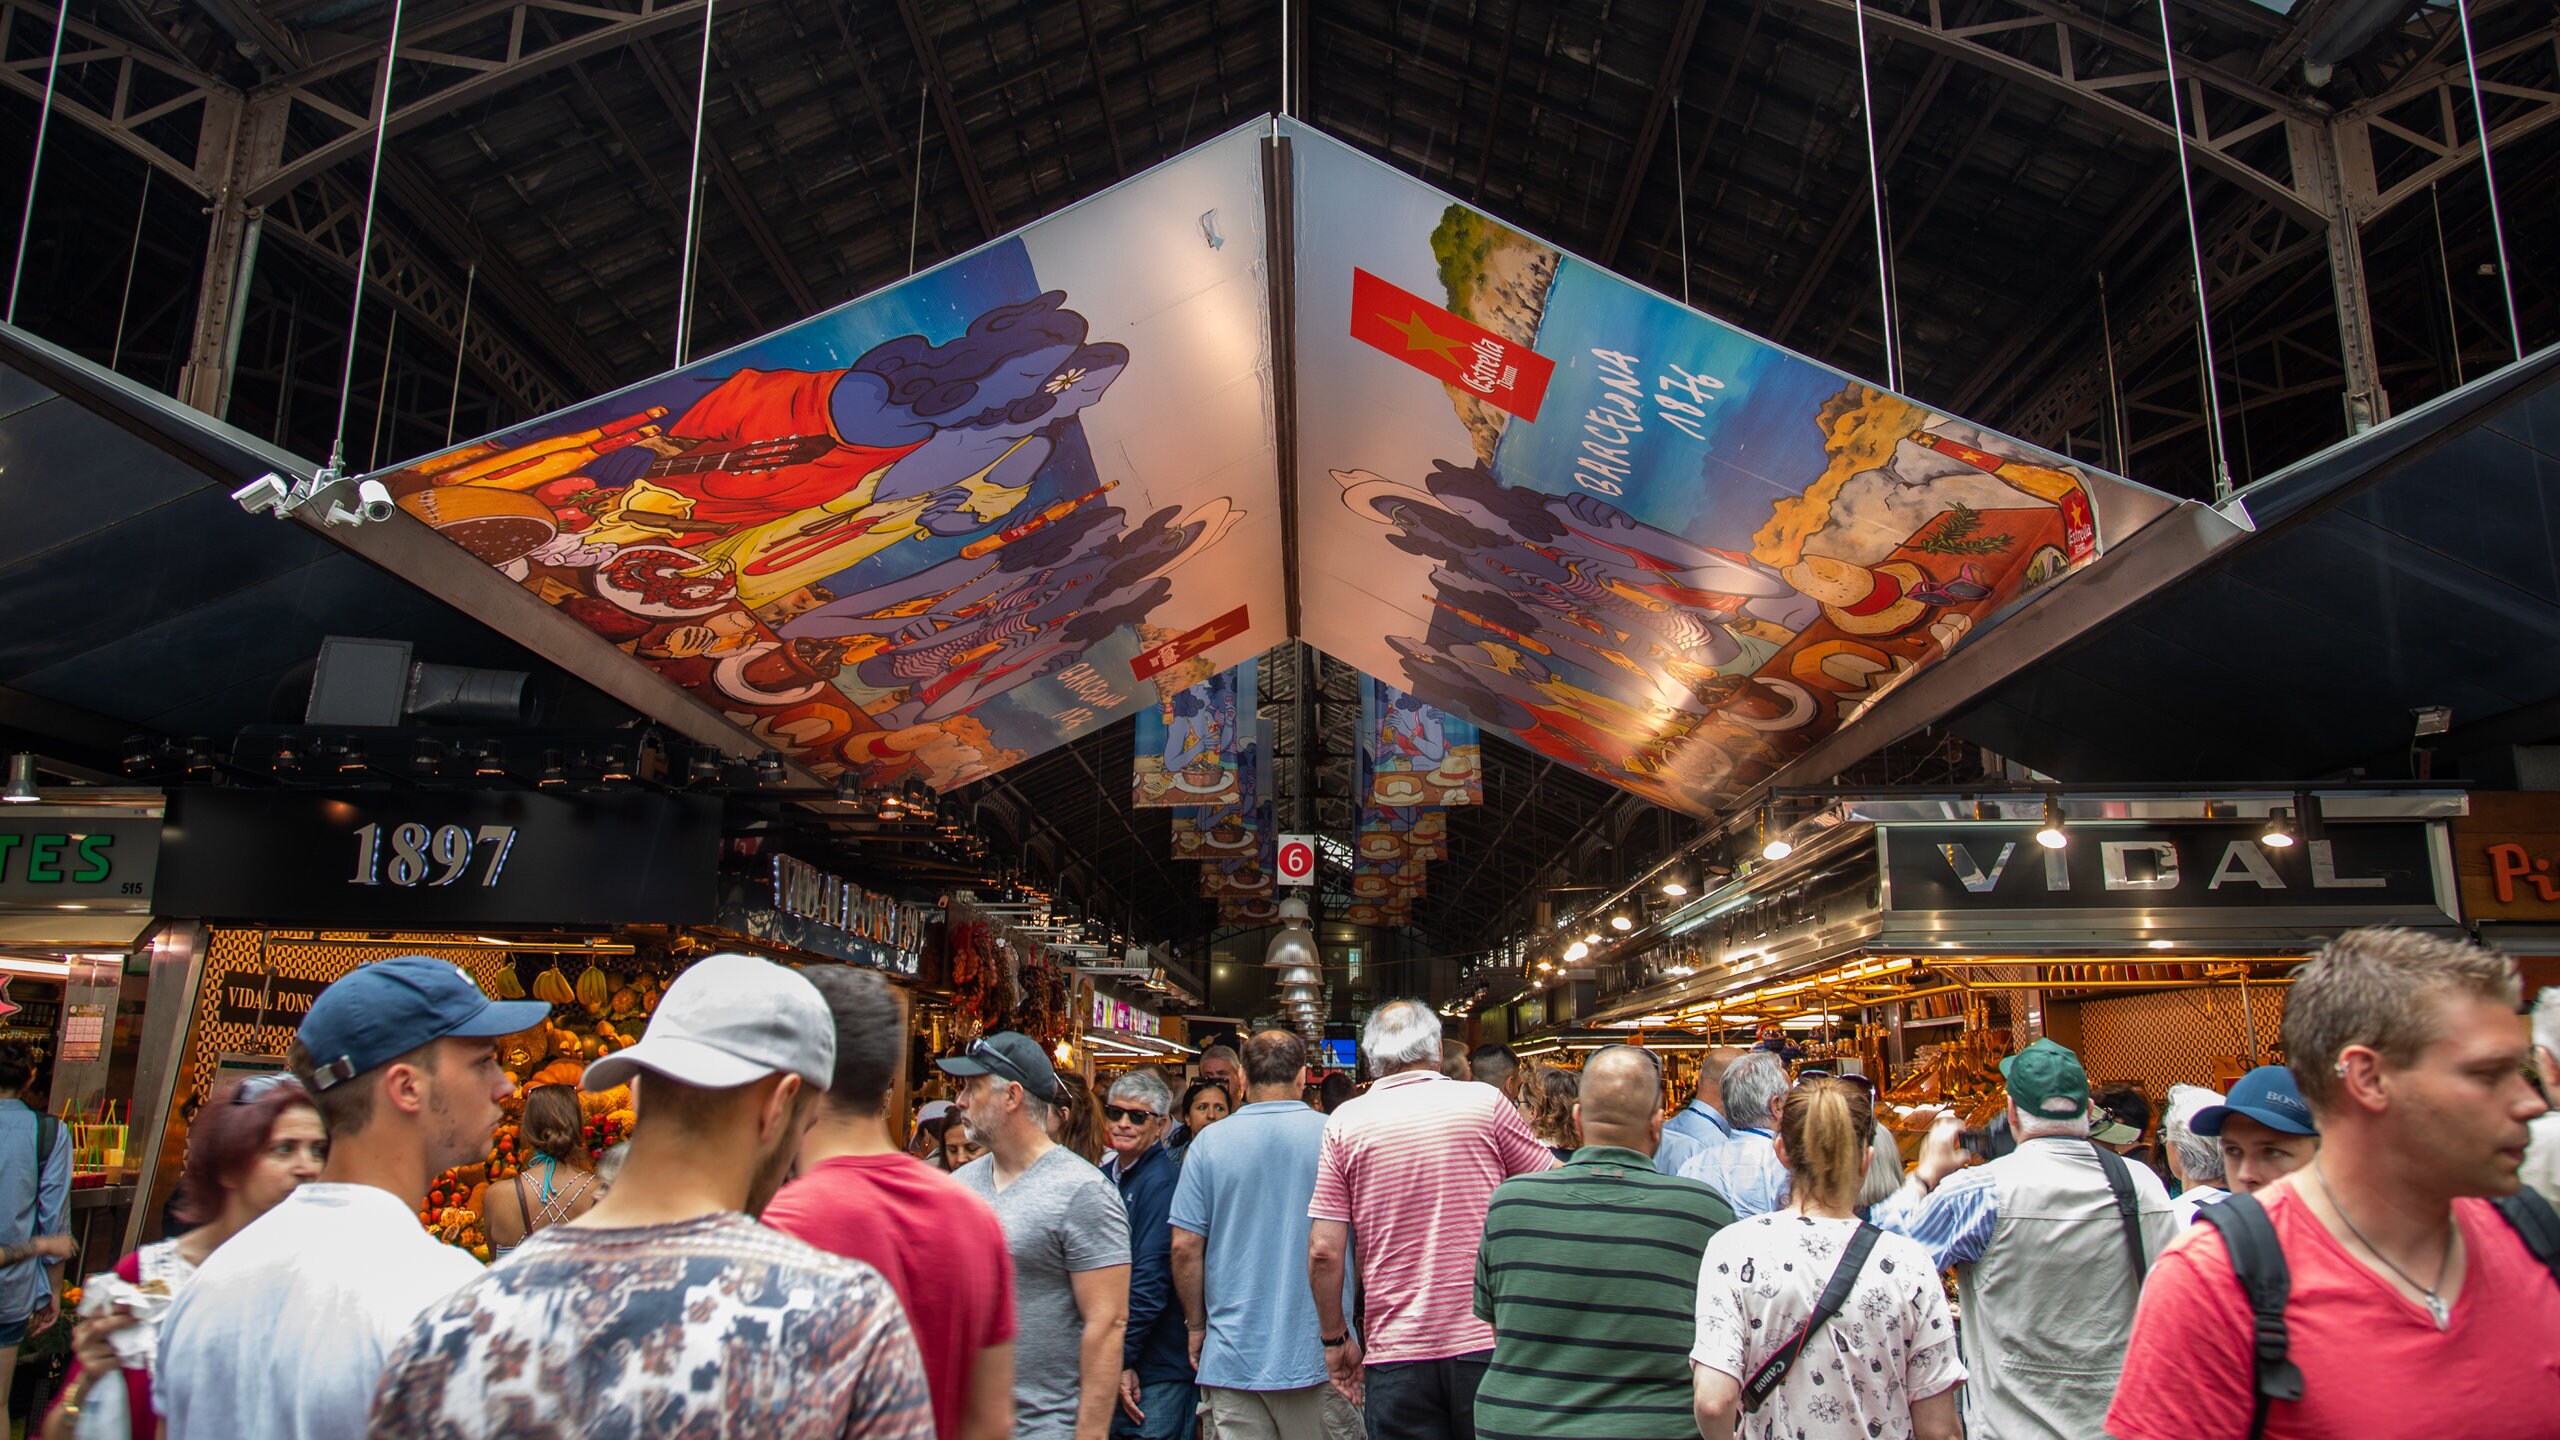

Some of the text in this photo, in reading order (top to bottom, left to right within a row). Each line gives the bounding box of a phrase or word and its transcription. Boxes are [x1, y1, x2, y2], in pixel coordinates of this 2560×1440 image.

[1460, 337, 1505, 394] Estrella
[1574, 348, 1644, 496] BARCELONA
[1653, 363, 1725, 440] 1876
[348, 822, 517, 888] 1897
[1288, 848, 1304, 872] 6
[1936, 839, 2387, 893] VIDAL
[121, 882, 143, 894] 515
[228, 986, 313, 1013] VIDAL PONS
[1754, 1360, 1785, 1393] Canon
